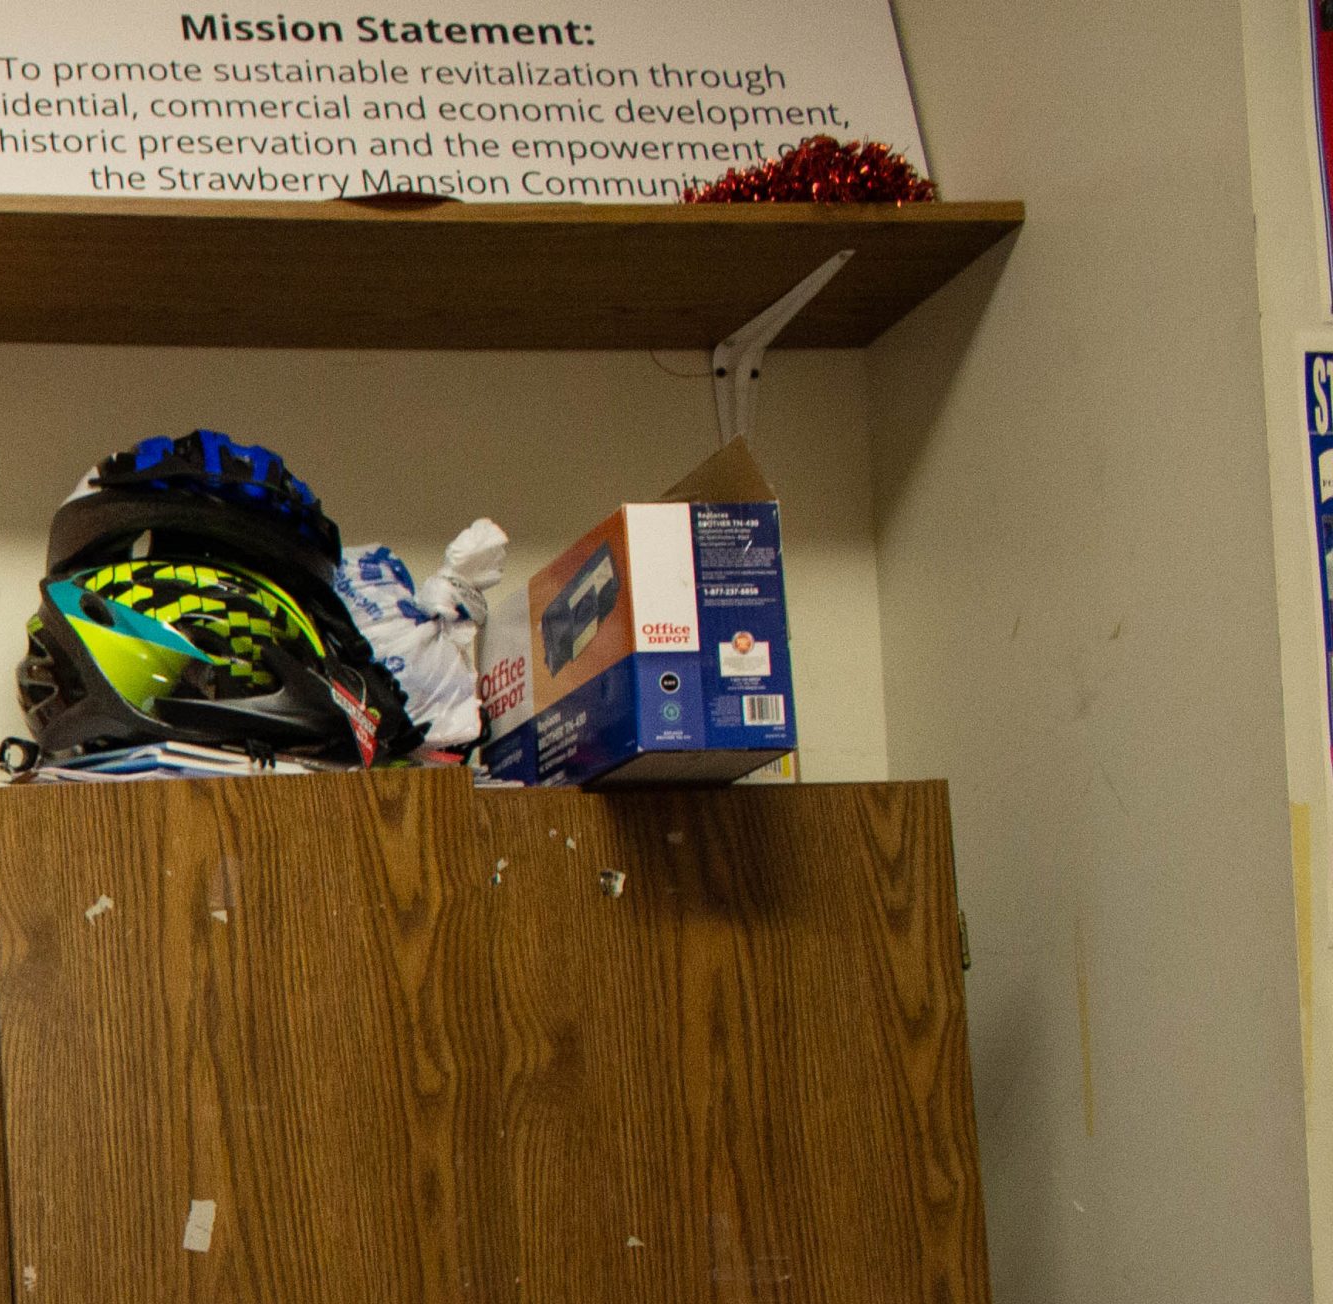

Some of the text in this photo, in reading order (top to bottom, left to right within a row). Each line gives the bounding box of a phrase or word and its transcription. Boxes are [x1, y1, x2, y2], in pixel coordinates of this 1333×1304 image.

[181, 13, 595, 46] Mission Statement:
[54, 59, 202, 88] promote
[213, 59, 409, 85] sustainable
[420, 61, 638, 88] revitalization
[648, 63, 786, 96] through
[149, 95, 351, 120] commercial
[363, 96, 426, 121] and
[438, 98, 605, 123] economic
[615, 99, 850, 131] development,
[138, 131, 358, 160] preservation
[369, 132, 433, 158] and
[444, 132, 500, 159] the
[511, 138, 765, 166] empowerment
[90, 165, 725, 199] the Strawberry Mansion Communit
[641, 623, 691, 636] Office
[647, 635, 691, 644] DEPOT
[480, 656, 525, 702] Office
[486, 682, 526, 721] DEPOT
